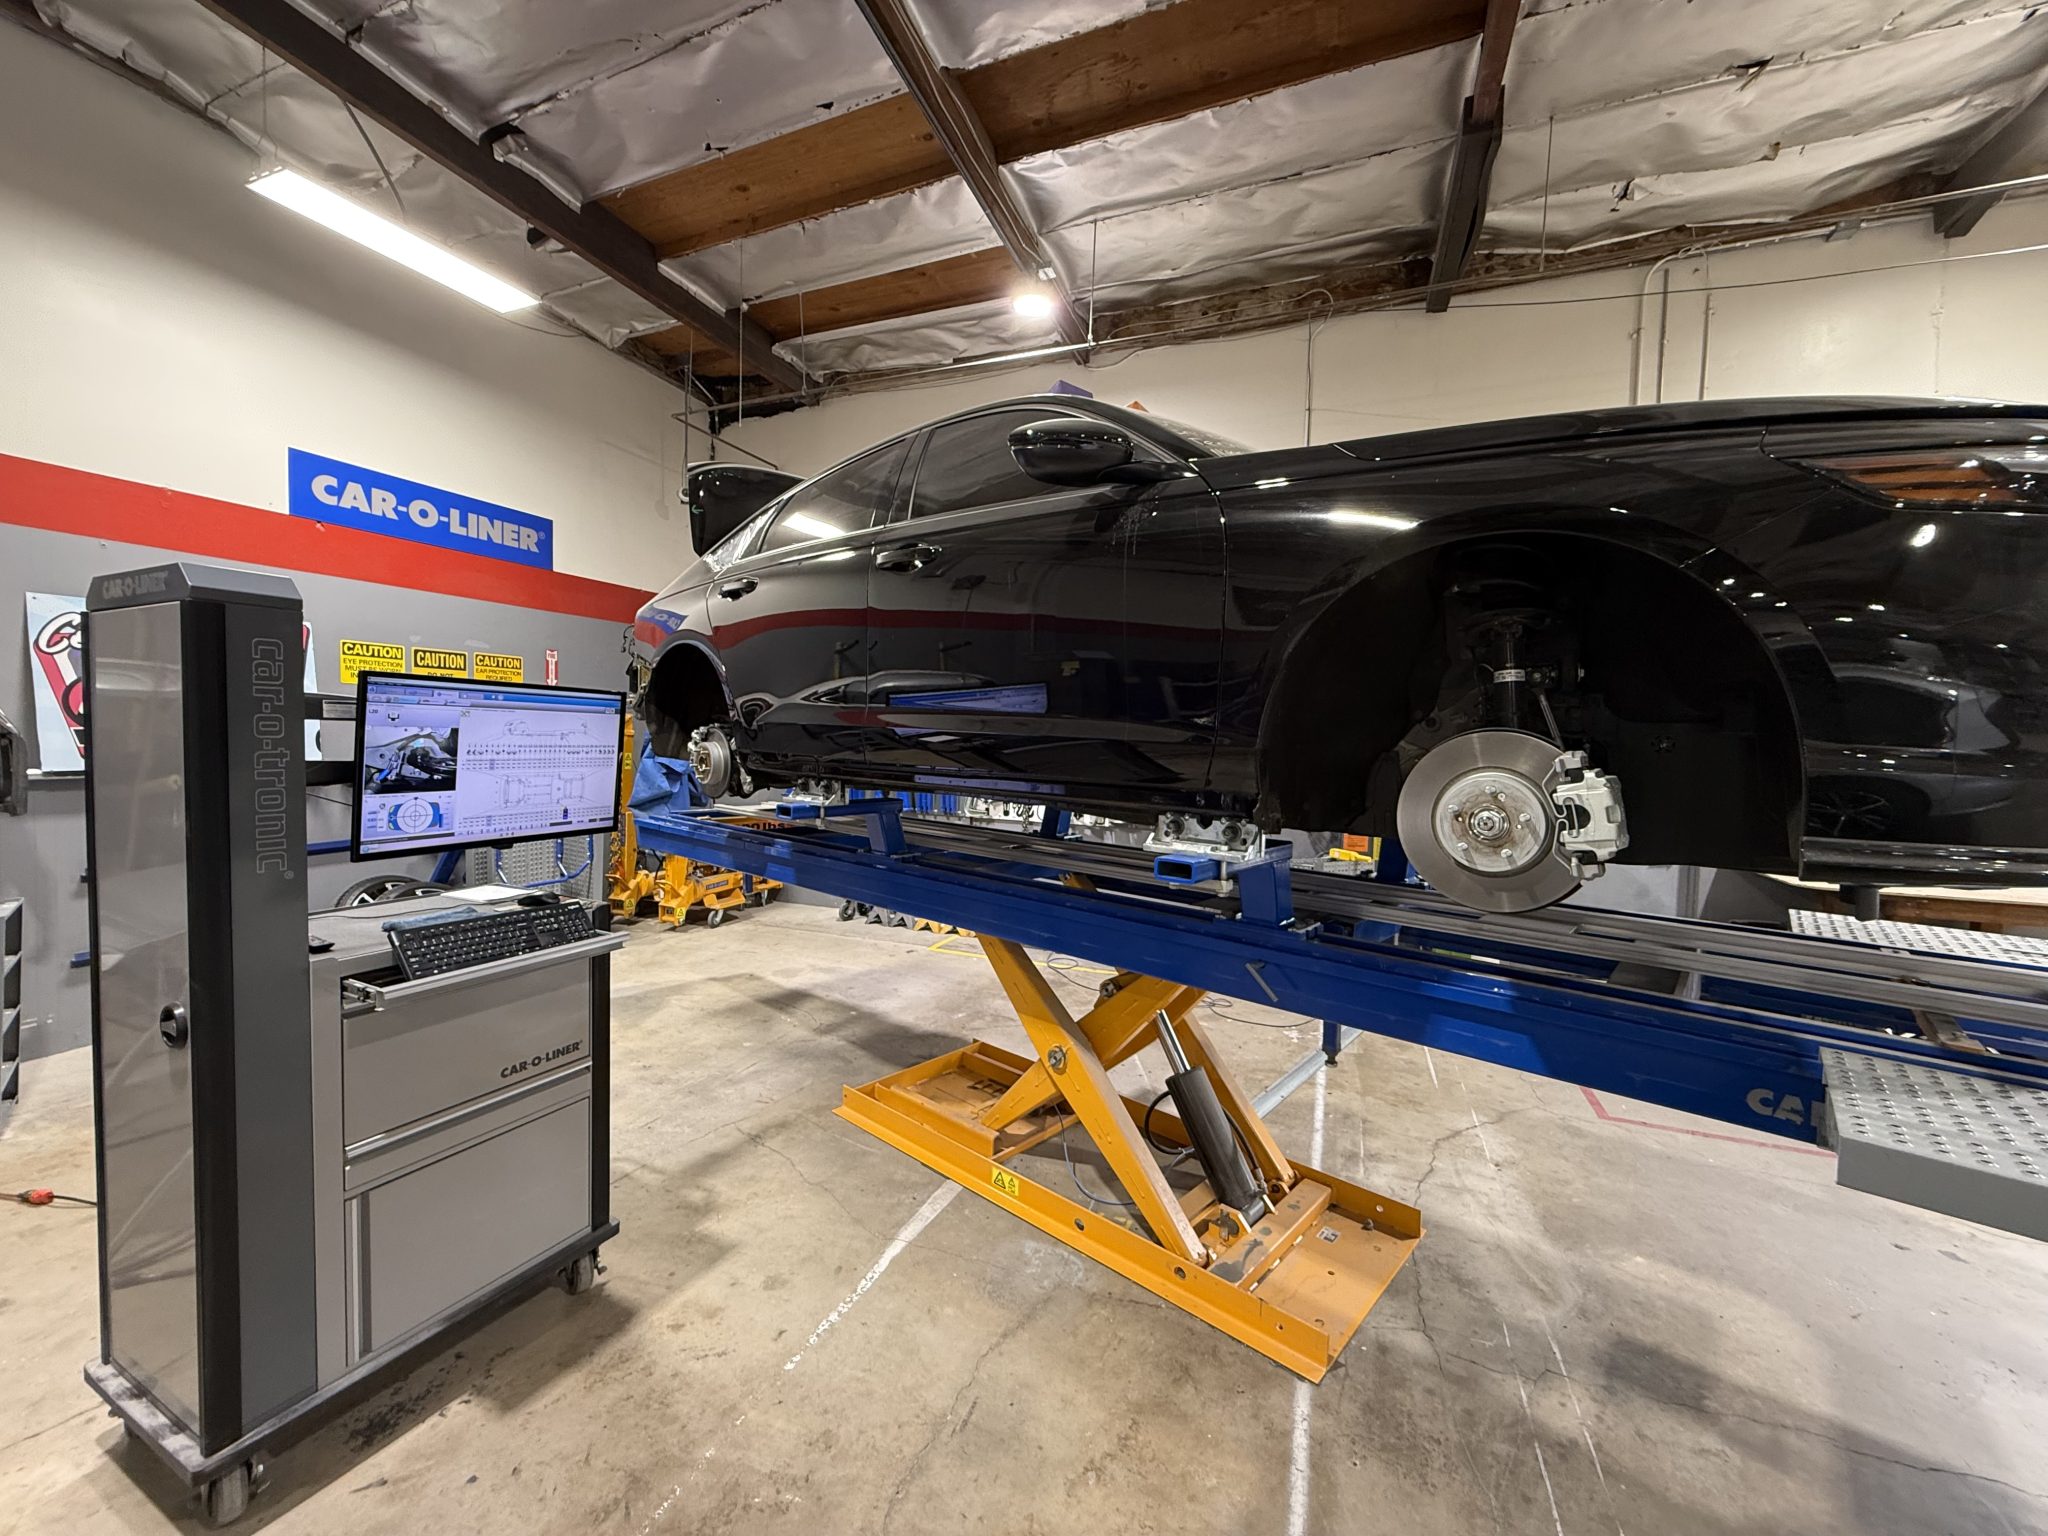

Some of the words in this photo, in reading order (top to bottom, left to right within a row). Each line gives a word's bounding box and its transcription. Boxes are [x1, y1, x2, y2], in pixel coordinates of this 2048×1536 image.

[343, 643, 402, 659] CAUTION
[359, 659, 403, 668] PROTECTION
[416, 651, 465, 669] CAUTION
[476, 655, 520, 669] CAUTION
[489, 669, 521, 677] PROTECTION
